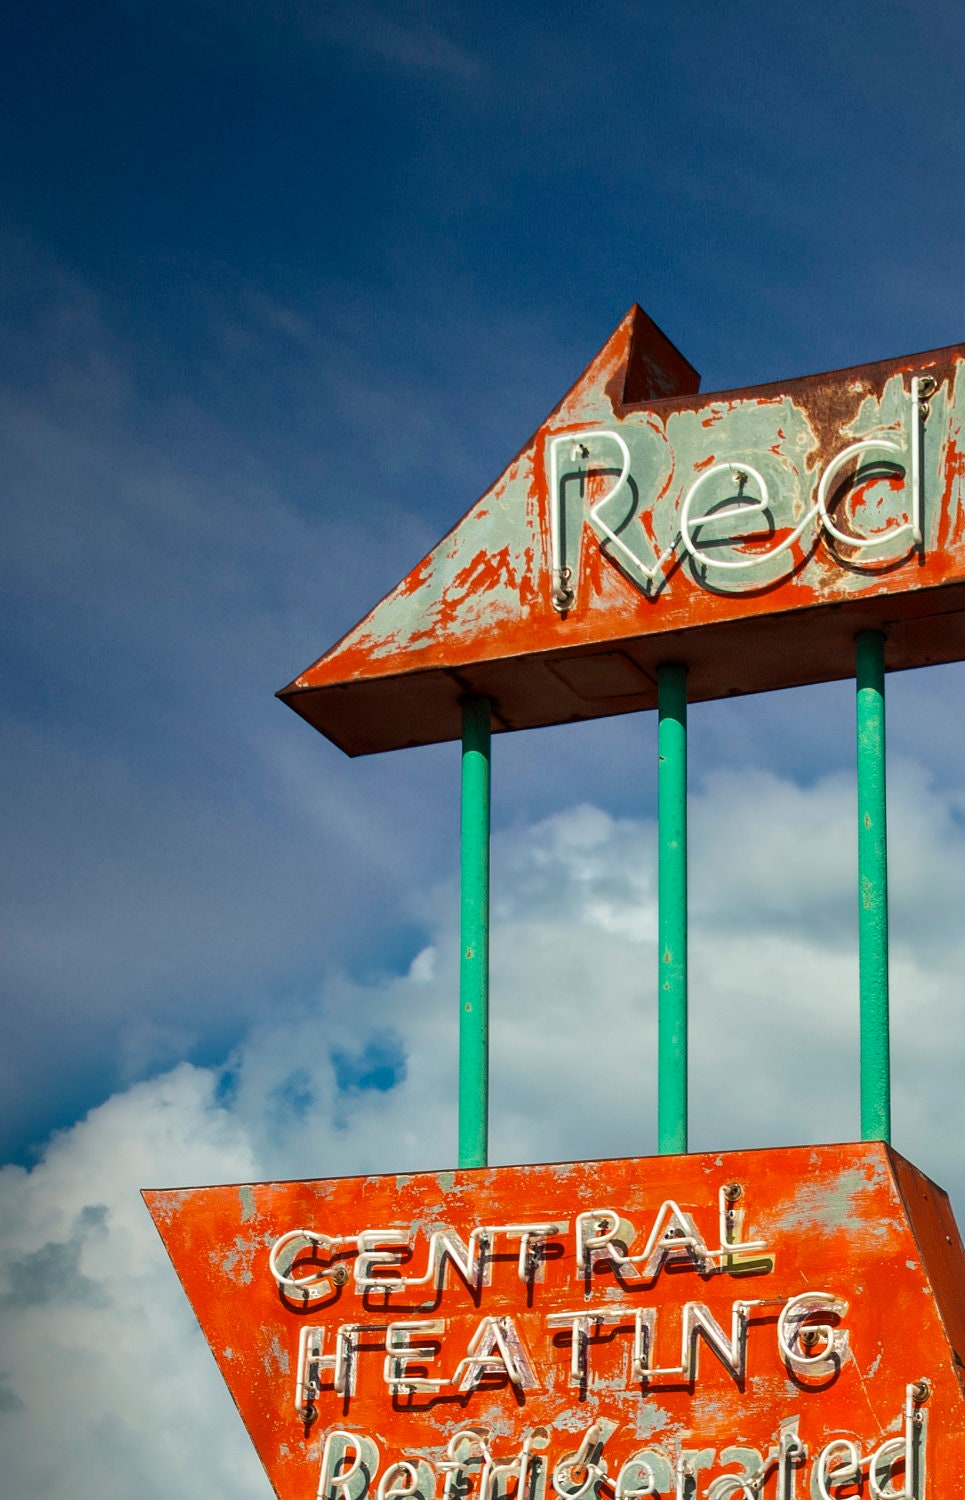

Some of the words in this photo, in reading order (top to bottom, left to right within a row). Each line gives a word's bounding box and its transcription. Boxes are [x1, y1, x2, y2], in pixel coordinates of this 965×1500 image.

[545, 374, 936, 612] Red
[269, 1185, 776, 1302] CENTRAL
[295, 1290, 850, 1420] HEATING
